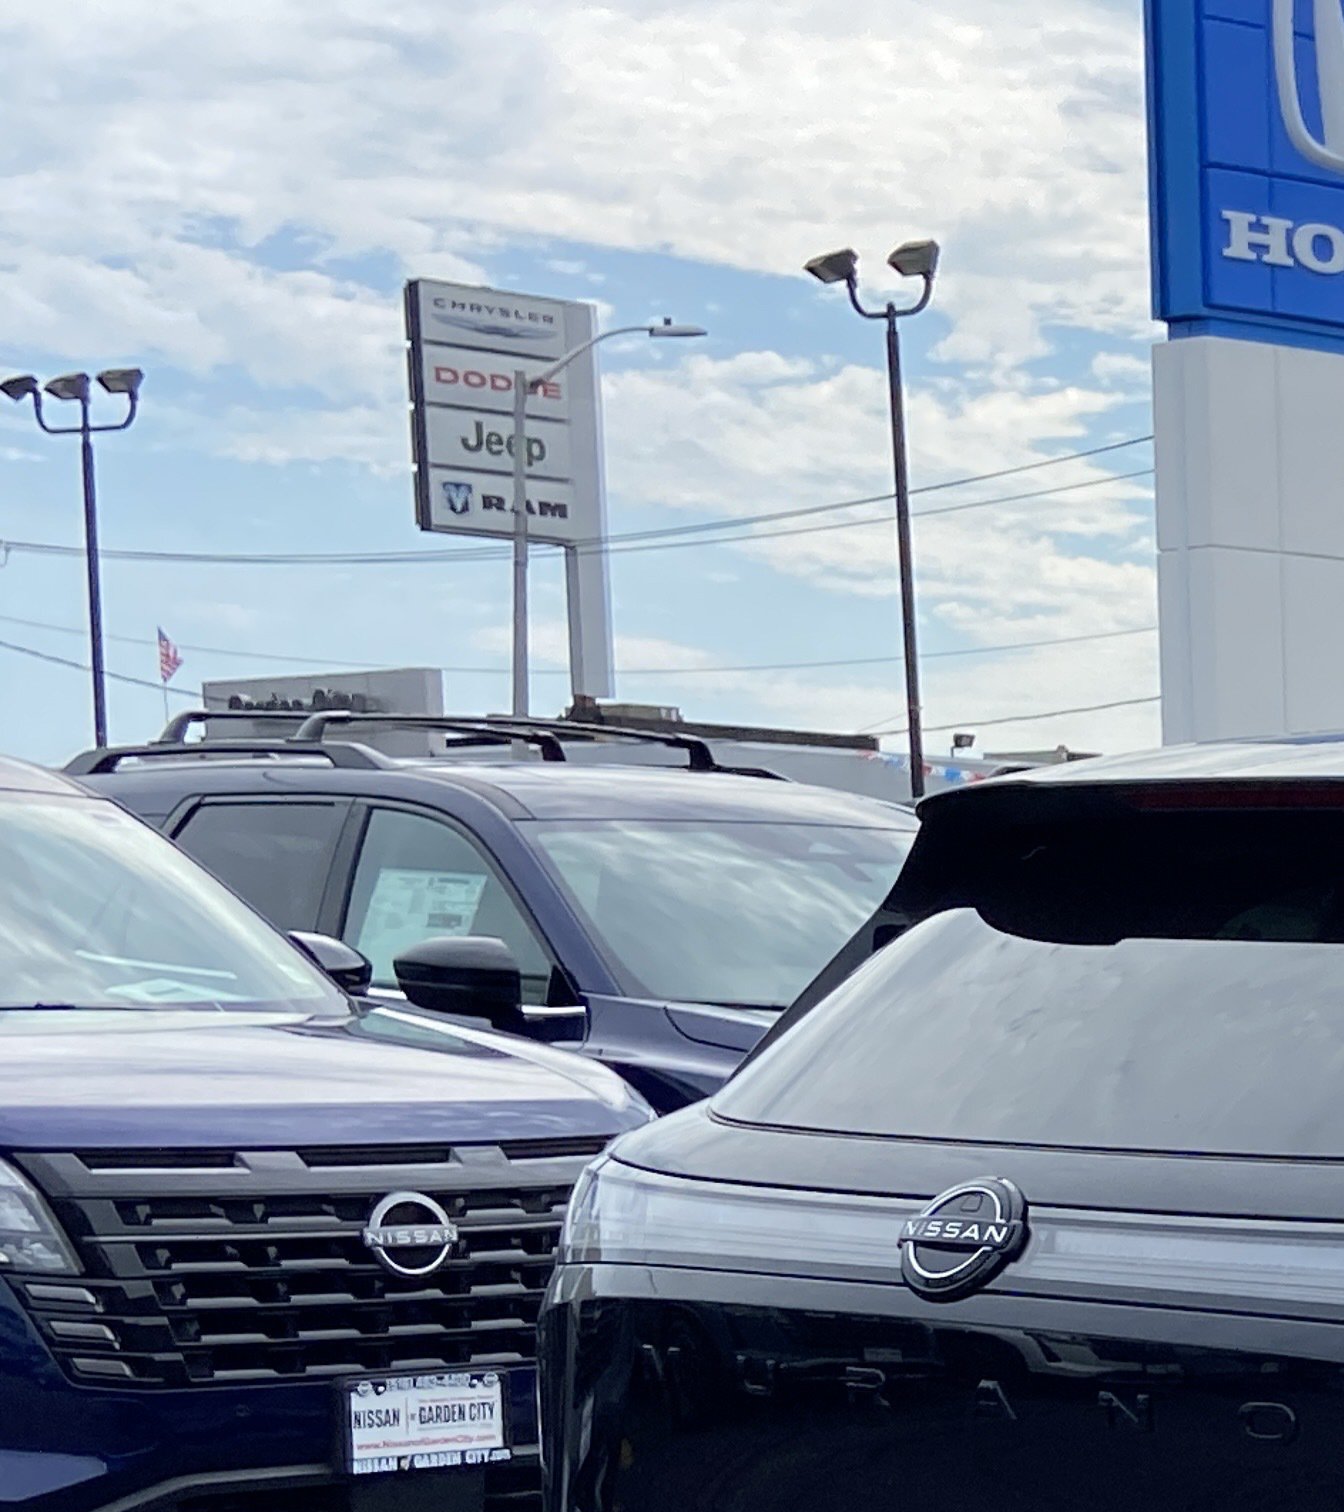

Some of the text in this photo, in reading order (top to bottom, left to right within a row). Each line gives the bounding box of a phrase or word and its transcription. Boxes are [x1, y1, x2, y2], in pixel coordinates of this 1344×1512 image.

[433, 298, 554, 325] CHRYSLER
[366, 1229, 457, 1246] NISSAN
[905, 1221, 1008, 1242] NISSAN
[353, 1407, 400, 1429] NISSAN
[419, 1403, 466, 1425] GARDEN
[469, 1401, 495, 1422] CITY
